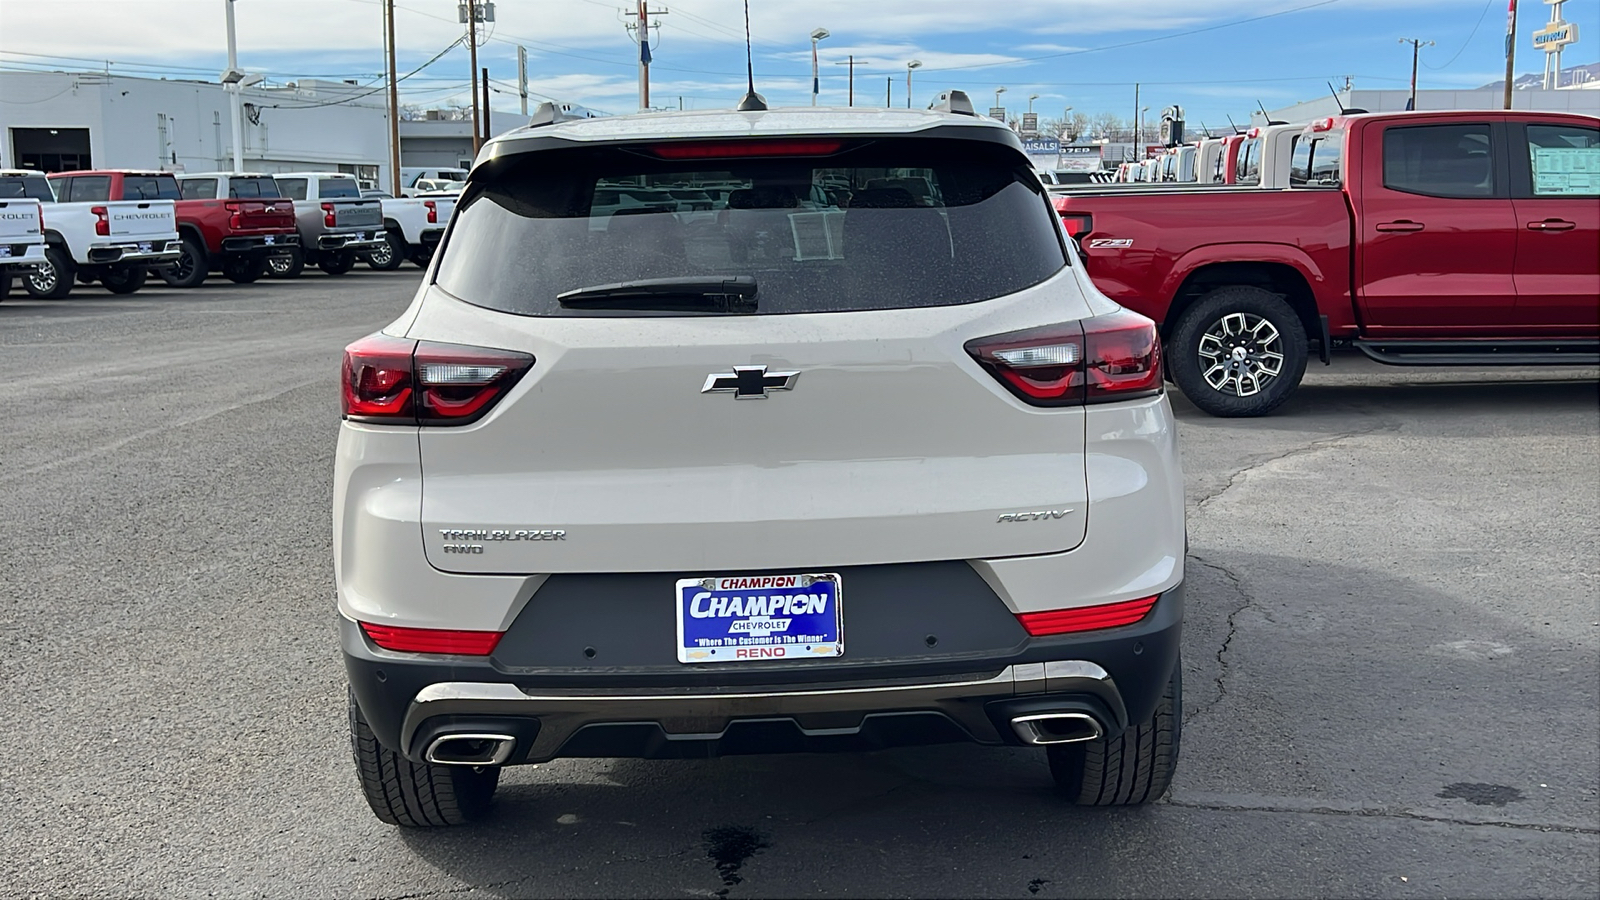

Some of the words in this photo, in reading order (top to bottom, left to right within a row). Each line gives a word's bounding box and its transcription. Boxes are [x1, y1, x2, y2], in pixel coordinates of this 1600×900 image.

[113, 212, 172, 221] CHEVROLET
[996, 508, 1075, 524] ACTIV
[439, 529, 567, 541] TRAILBLAZER
[443, 543, 484, 555] AWD
[721, 576, 796, 590] CHAMPION
[732, 620, 787, 631] CHEVROLET
[723, 636, 737, 646] The
[739, 635, 773, 646] Customer
[783, 634, 796, 644] The
[736, 647, 786, 659] RENO
